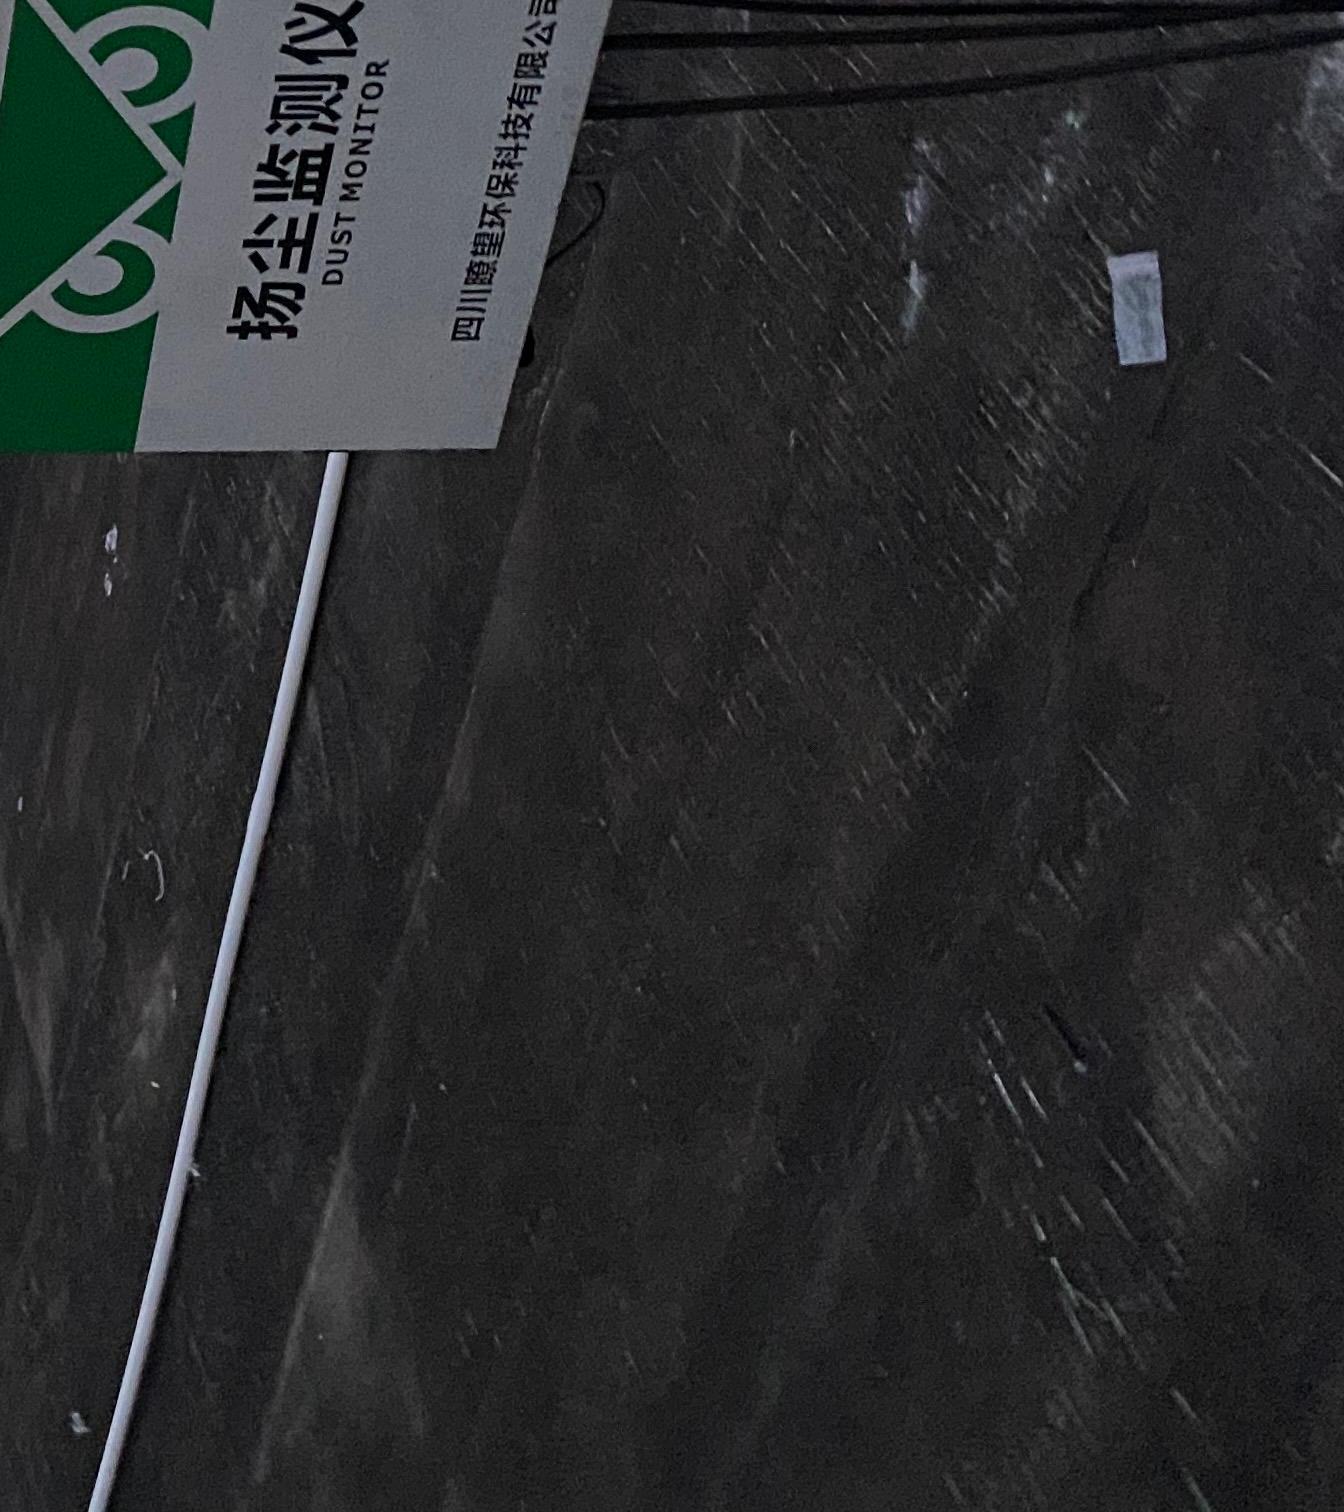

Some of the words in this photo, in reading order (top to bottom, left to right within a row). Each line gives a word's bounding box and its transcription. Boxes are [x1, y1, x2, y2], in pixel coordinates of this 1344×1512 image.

[226, 0, 365, 341] 扬尘监测仪
[322, 211, 356, 286] DUST
[340, 57, 390, 202] MONITOR
